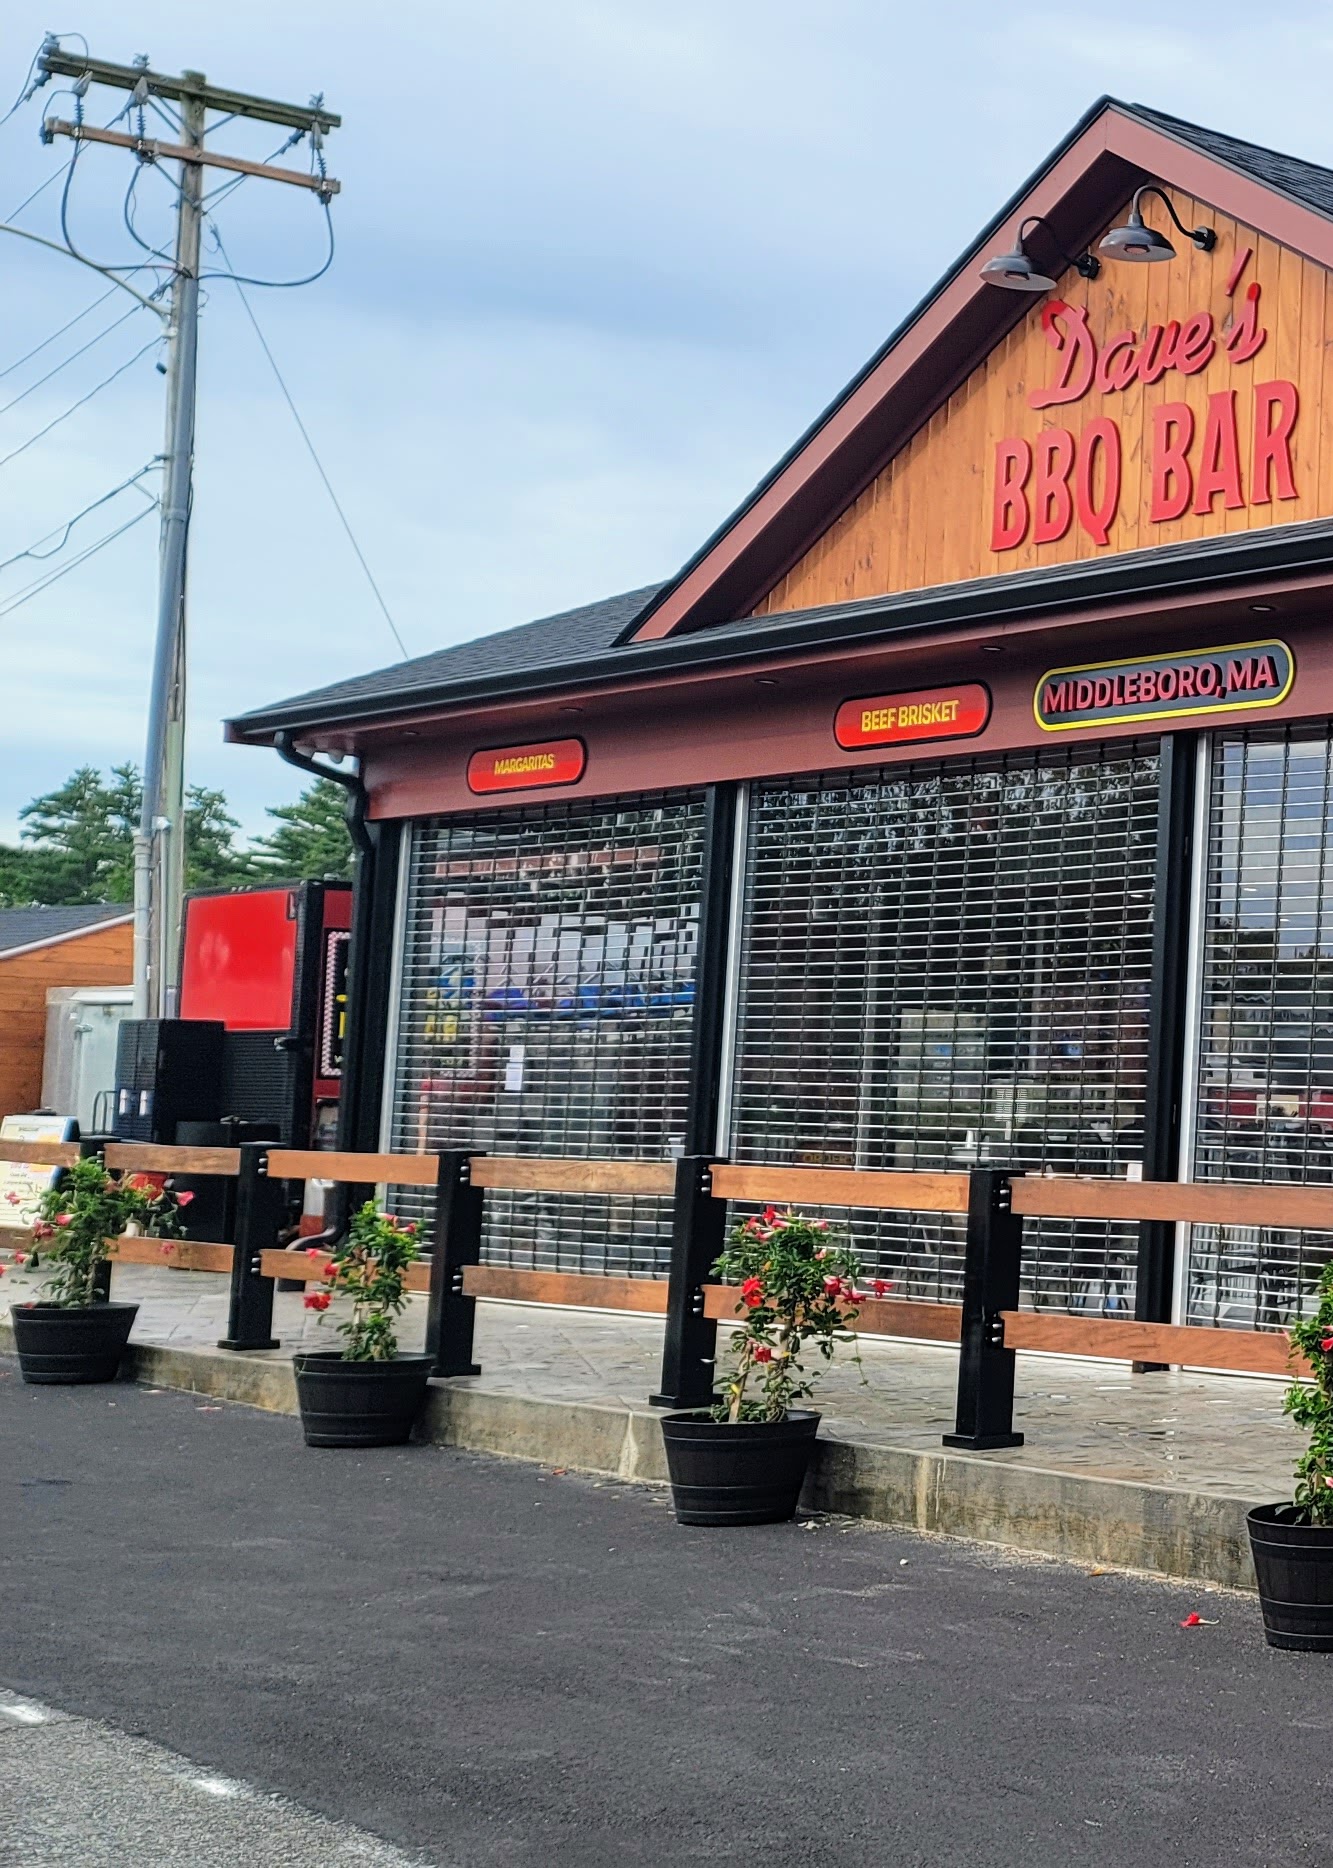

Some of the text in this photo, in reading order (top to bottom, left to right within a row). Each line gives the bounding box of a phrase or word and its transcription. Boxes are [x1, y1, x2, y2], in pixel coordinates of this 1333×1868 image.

[1028, 248, 1267, 409] Dave's
[990, 379, 1300, 552] BBQ BAR
[861, 699, 960, 732] BEEF BRISKET
[493, 753, 557, 776] MARGARITAS
